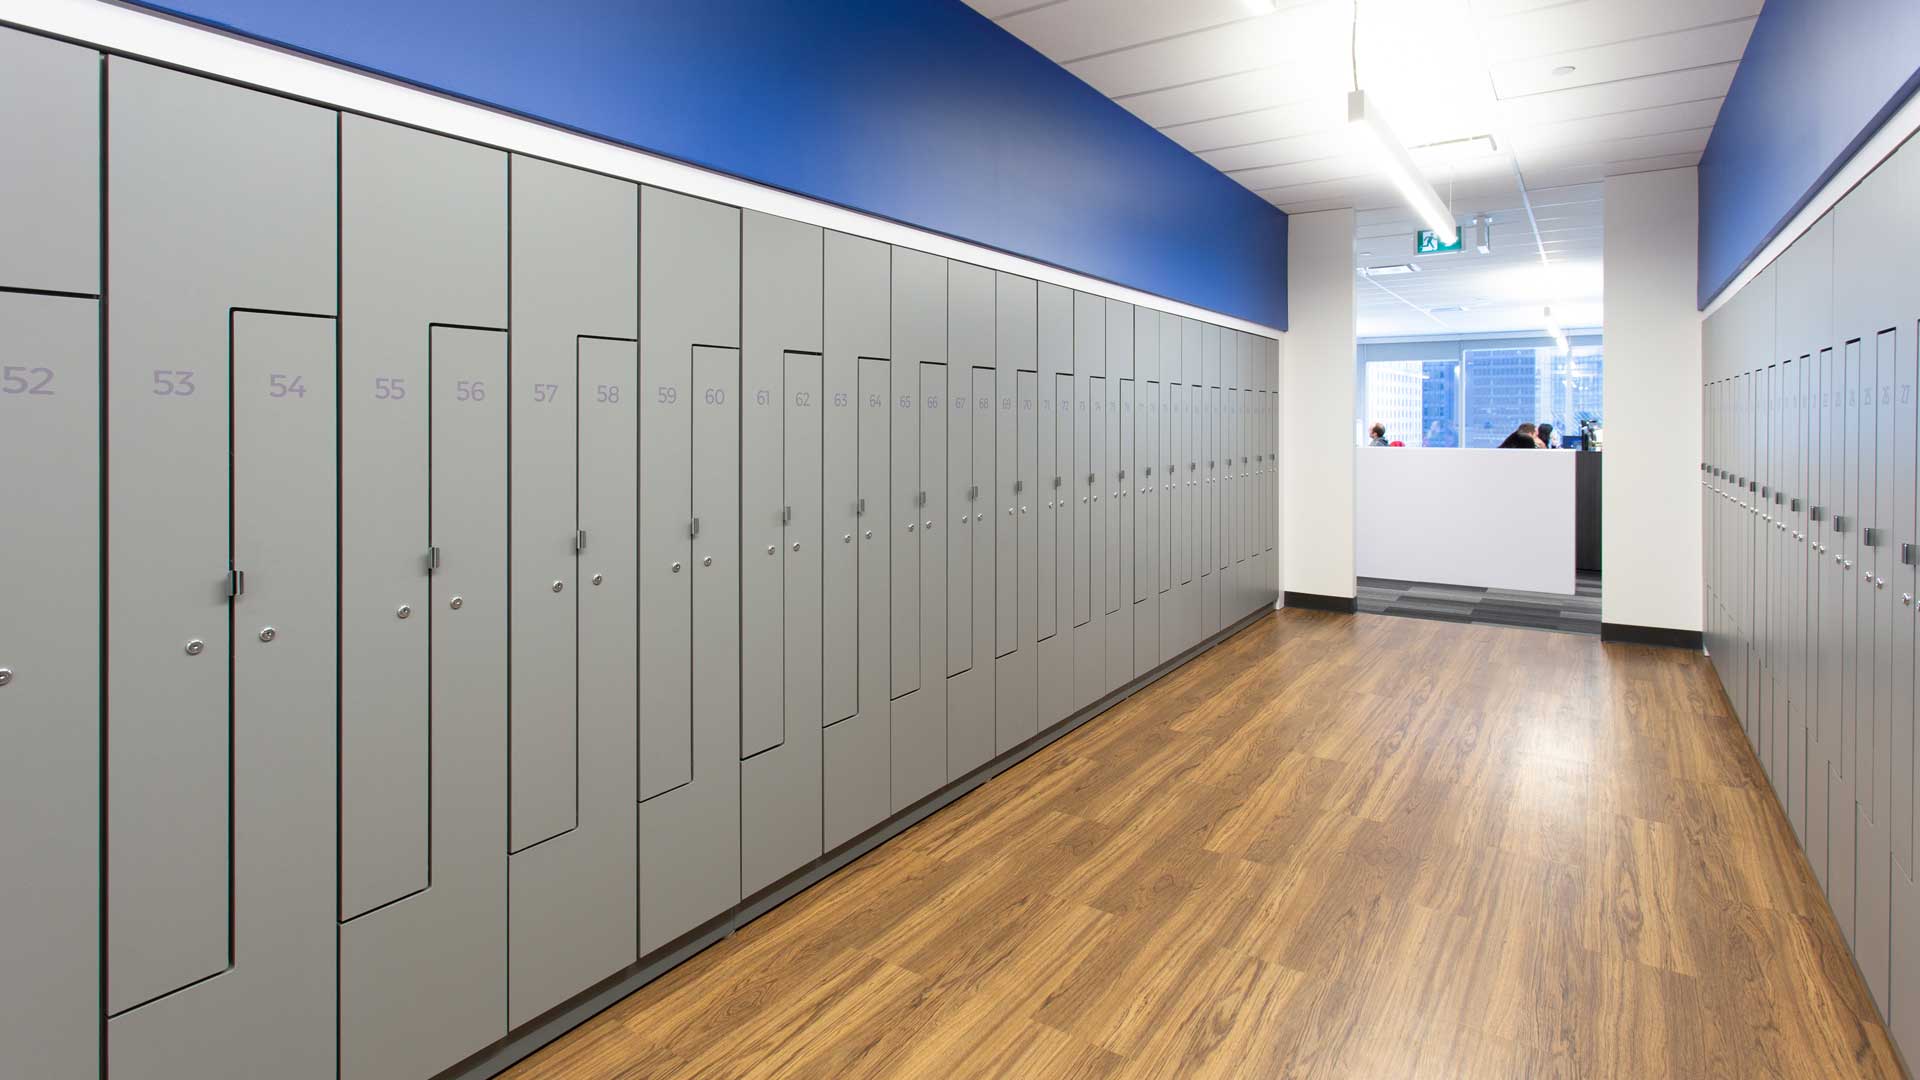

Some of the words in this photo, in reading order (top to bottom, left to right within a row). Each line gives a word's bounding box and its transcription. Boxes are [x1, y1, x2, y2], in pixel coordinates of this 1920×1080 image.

[2, 365, 55, 396] 52
[153, 370, 195, 396] 53
[269, 374, 306, 398] 54
[375, 378, 406, 400] 55
[456, 381, 486, 402] 56
[534, 383, 559, 403] 57
[597, 385, 620, 403] 58
[658, 387, 677, 405] 59
[705, 388, 725, 405] 60
[757, 390, 770, 406] 61
[795, 392, 811, 407] 62
[834, 393, 848, 407] 63
[869, 394, 882, 408] 64
[900, 395, 911, 409] 65
[927, 396, 938, 409] 66
[954, 397, 966, 409] 67
[978, 397, 989, 409] 68
